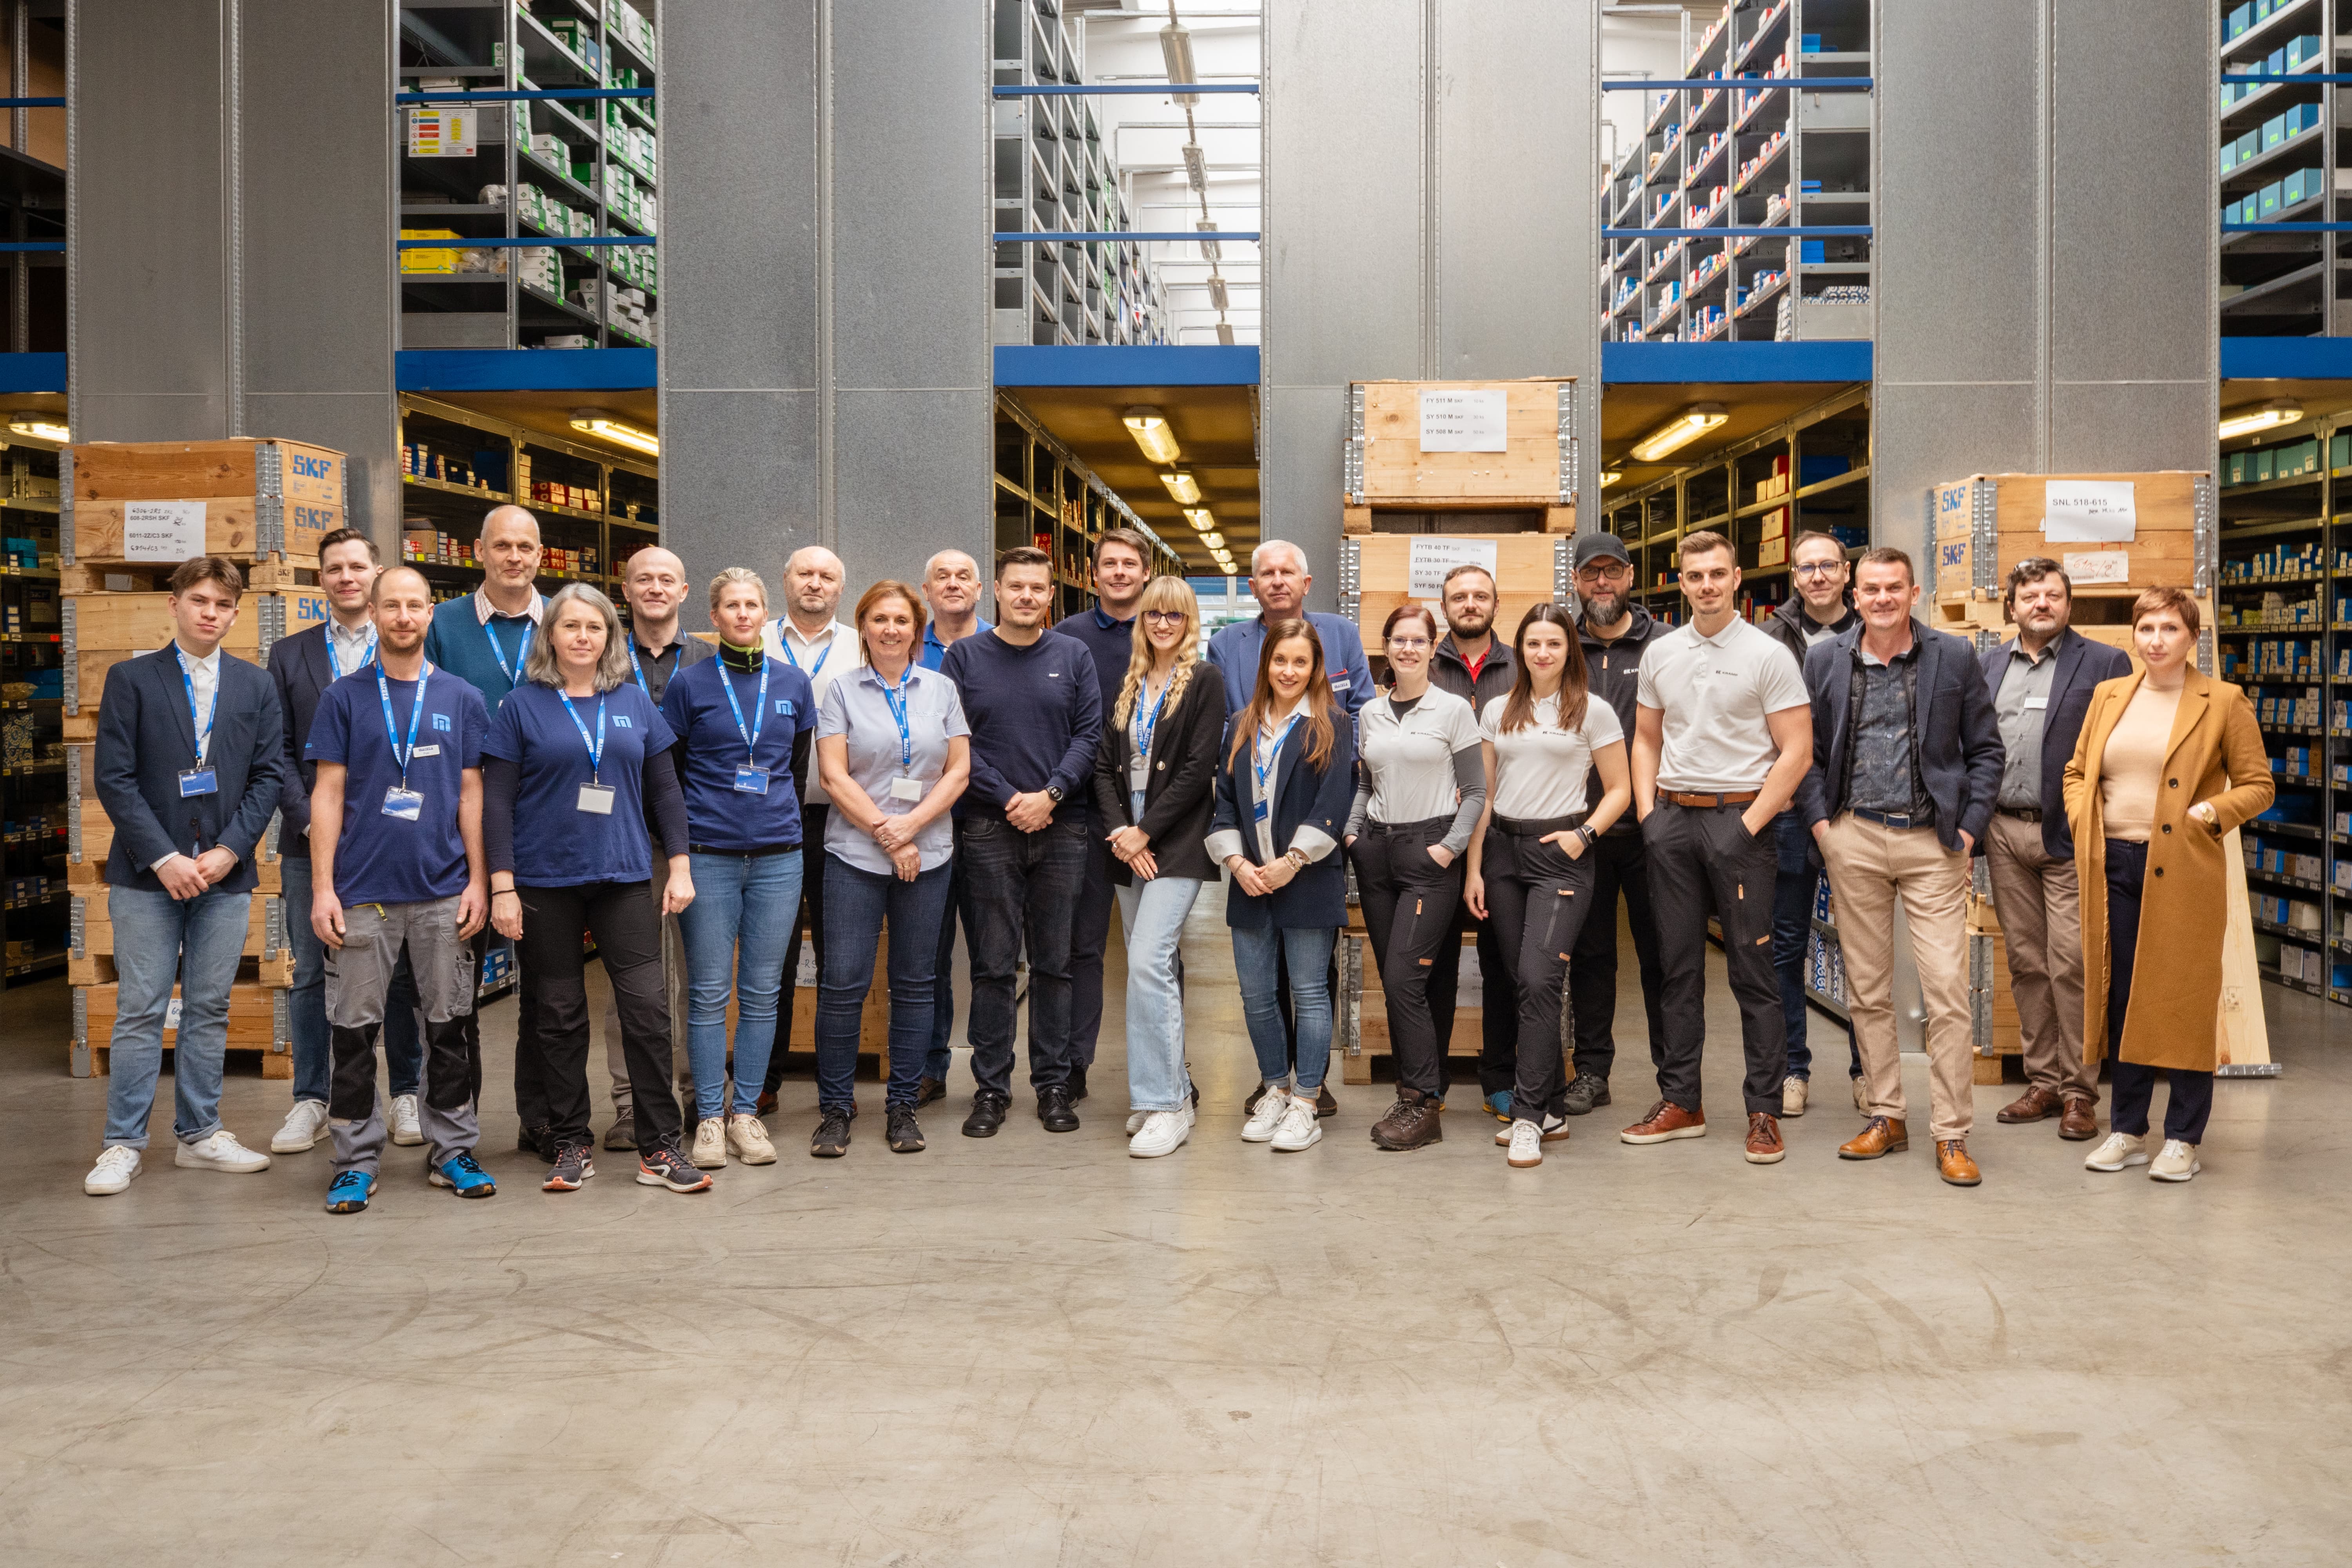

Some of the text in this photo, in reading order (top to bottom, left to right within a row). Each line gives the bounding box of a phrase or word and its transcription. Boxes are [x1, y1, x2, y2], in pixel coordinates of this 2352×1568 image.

[292, 455, 332, 479] SKF
[1942, 486, 1966, 512] SKF
[295, 506, 333, 530] SKF
[1943, 543, 1966, 566] SKF
[1142, 728, 1151, 749] MATEZA
